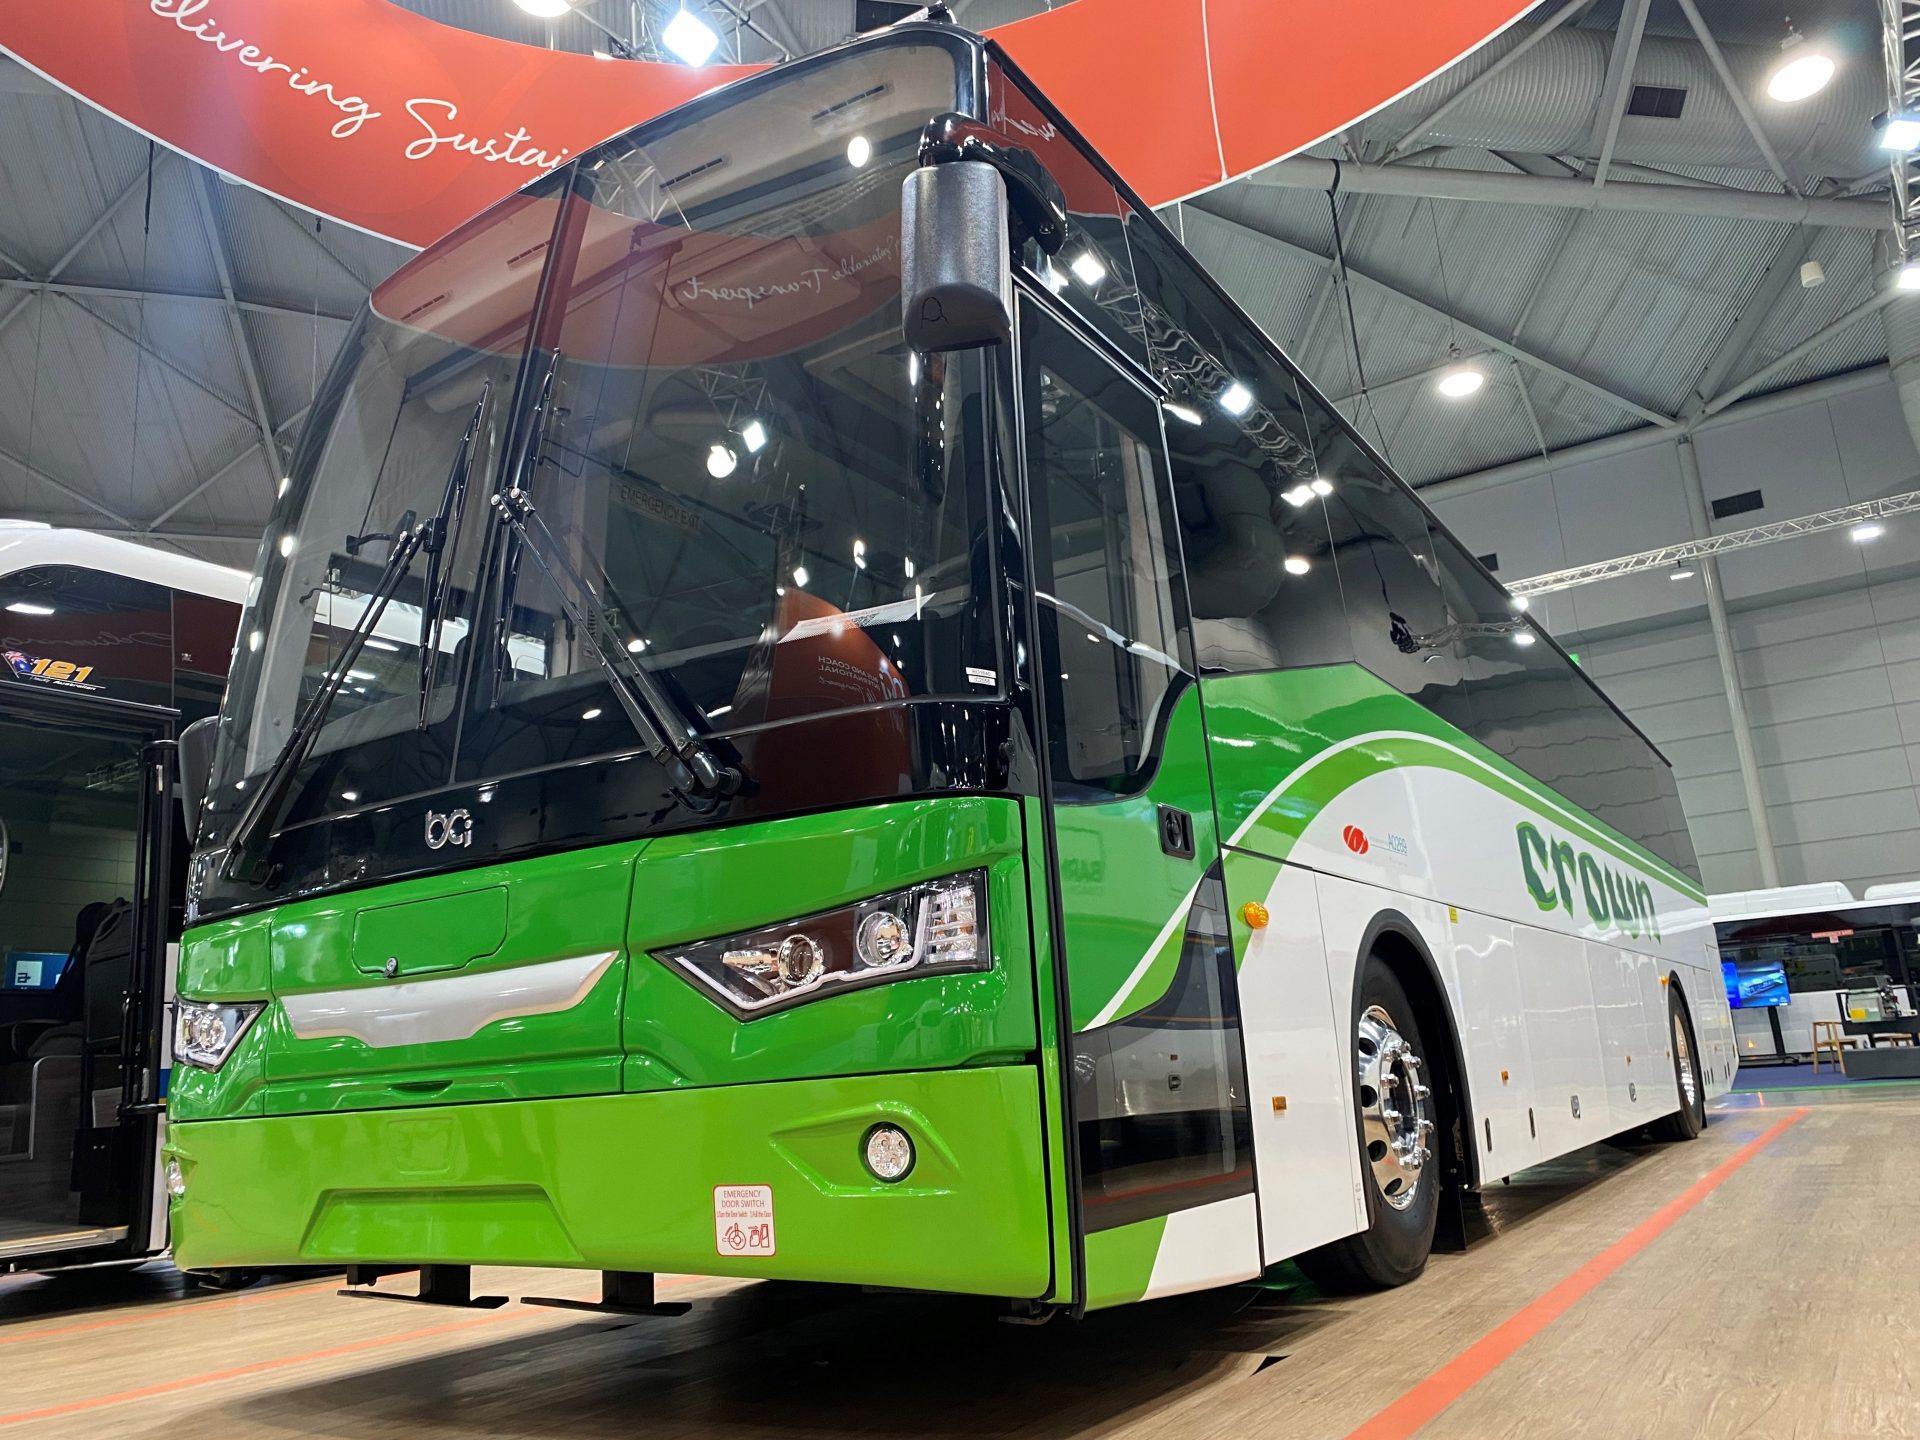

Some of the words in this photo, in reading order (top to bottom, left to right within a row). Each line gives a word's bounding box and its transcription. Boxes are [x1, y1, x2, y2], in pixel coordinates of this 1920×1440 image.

[405, 98, 569, 169] Sustai
[620, 485, 680, 520] EMERGENCY
[31, 658, 95, 683] 121
[1515, 821, 1661, 945] crown
[722, 1200, 740, 1208] DOOR
[741, 1200, 765, 1208] SWITCH
[723, 1190, 762, 1198] EMERGENCY
